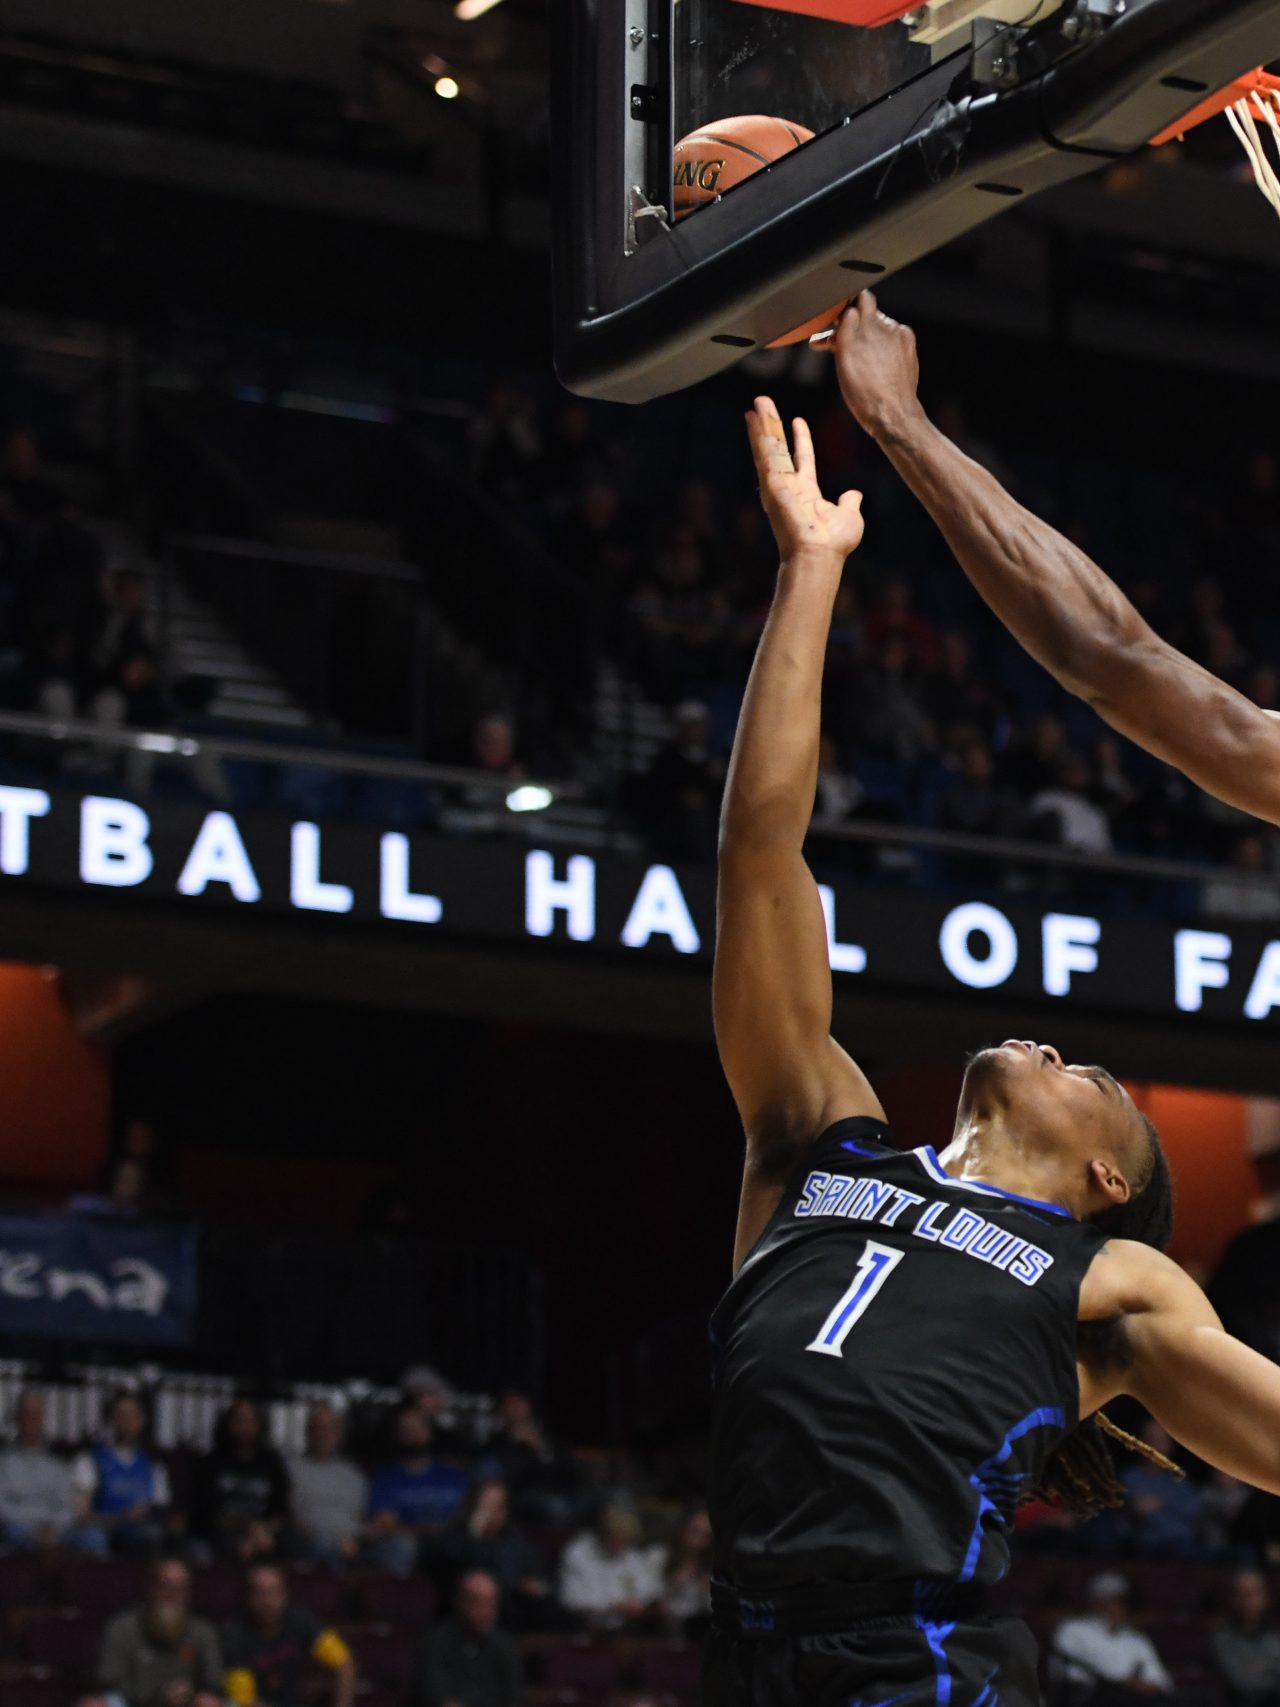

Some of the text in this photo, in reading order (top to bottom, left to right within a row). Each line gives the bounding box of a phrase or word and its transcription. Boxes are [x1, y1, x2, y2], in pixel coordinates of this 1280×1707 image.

[525, 849, 868, 973] HAL
[938, 901, 1101, 997] OF
[794, 1170, 1054, 1287] SAINT LOUIS
[804, 1239, 906, 1359] 1
